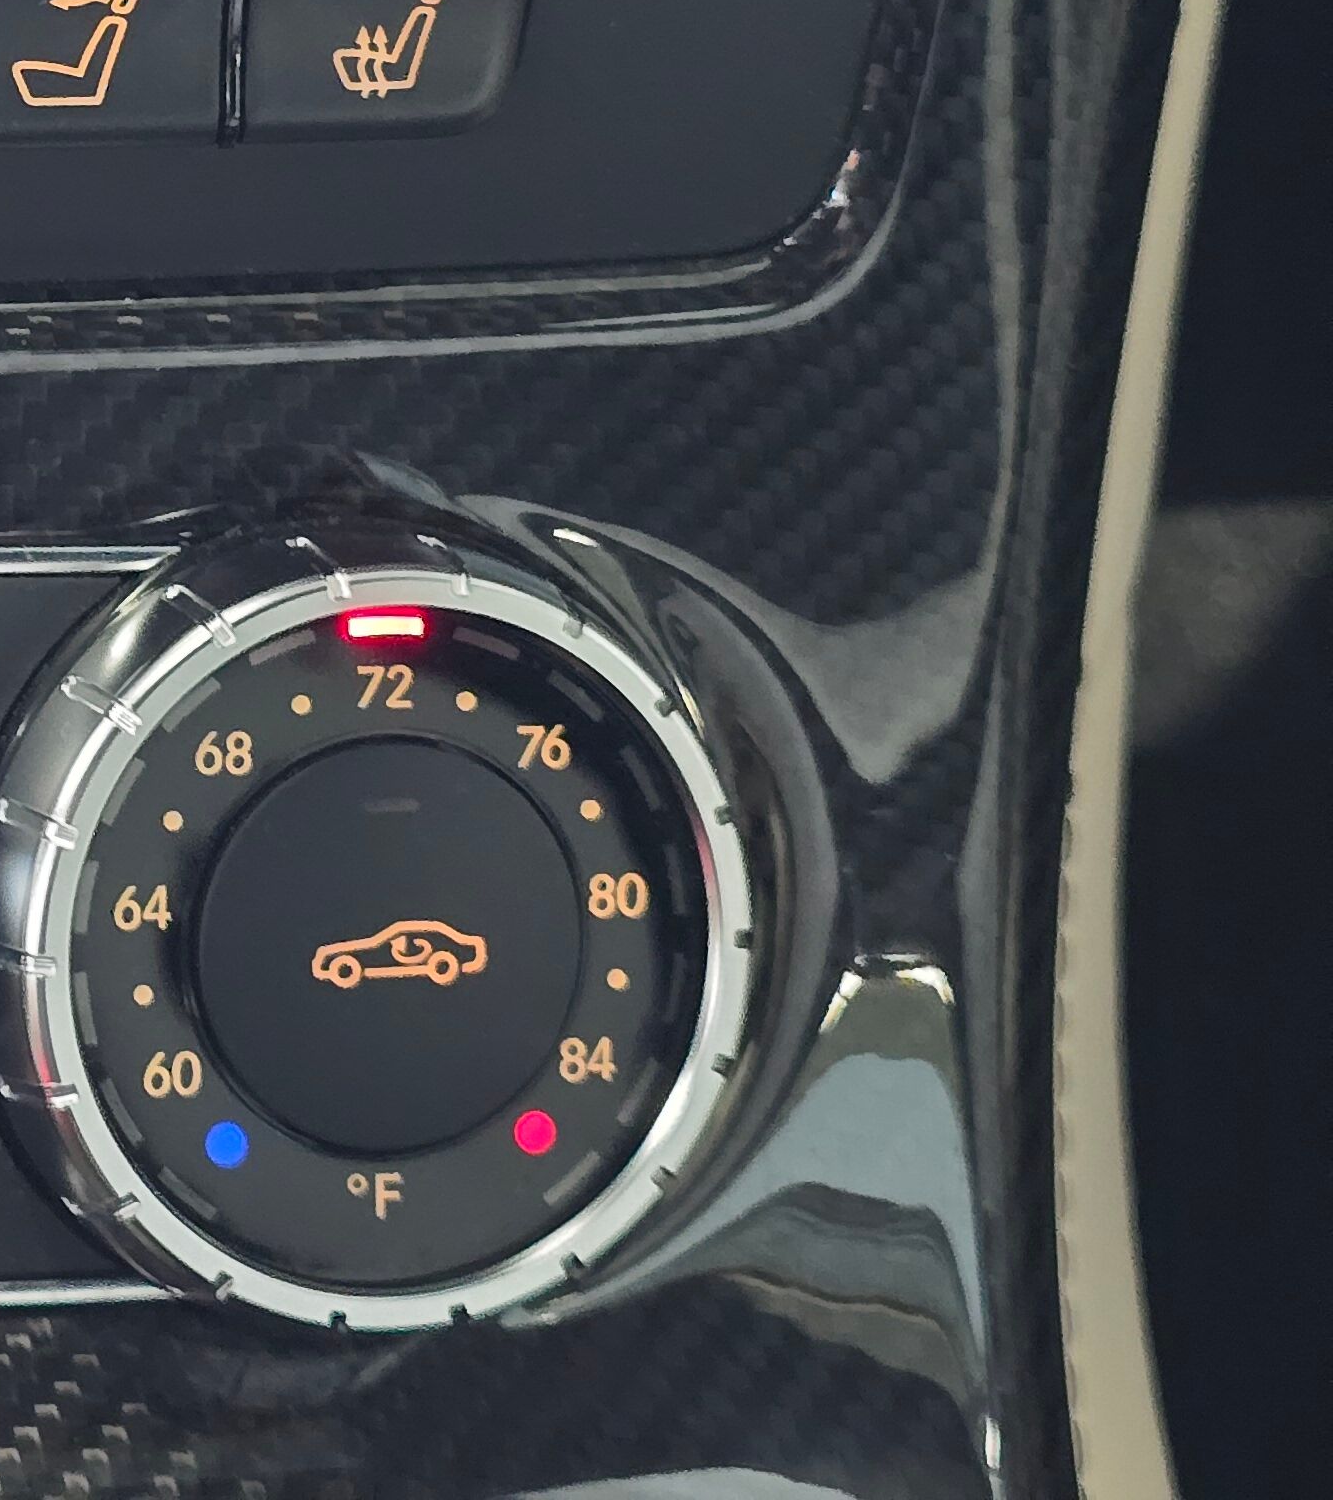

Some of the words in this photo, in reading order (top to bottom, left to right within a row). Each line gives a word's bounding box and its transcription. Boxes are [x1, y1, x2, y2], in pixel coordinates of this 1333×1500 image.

[356, 664, 414, 709] 72
[194, 730, 253, 776] 68
[516, 724, 571, 770] 76
[113, 884, 173, 932] 64
[588, 872, 649, 920] 80
[143, 1050, 203, 1099] 60
[559, 1036, 617, 1084] 84
[347, 1171, 404, 1220] °F
